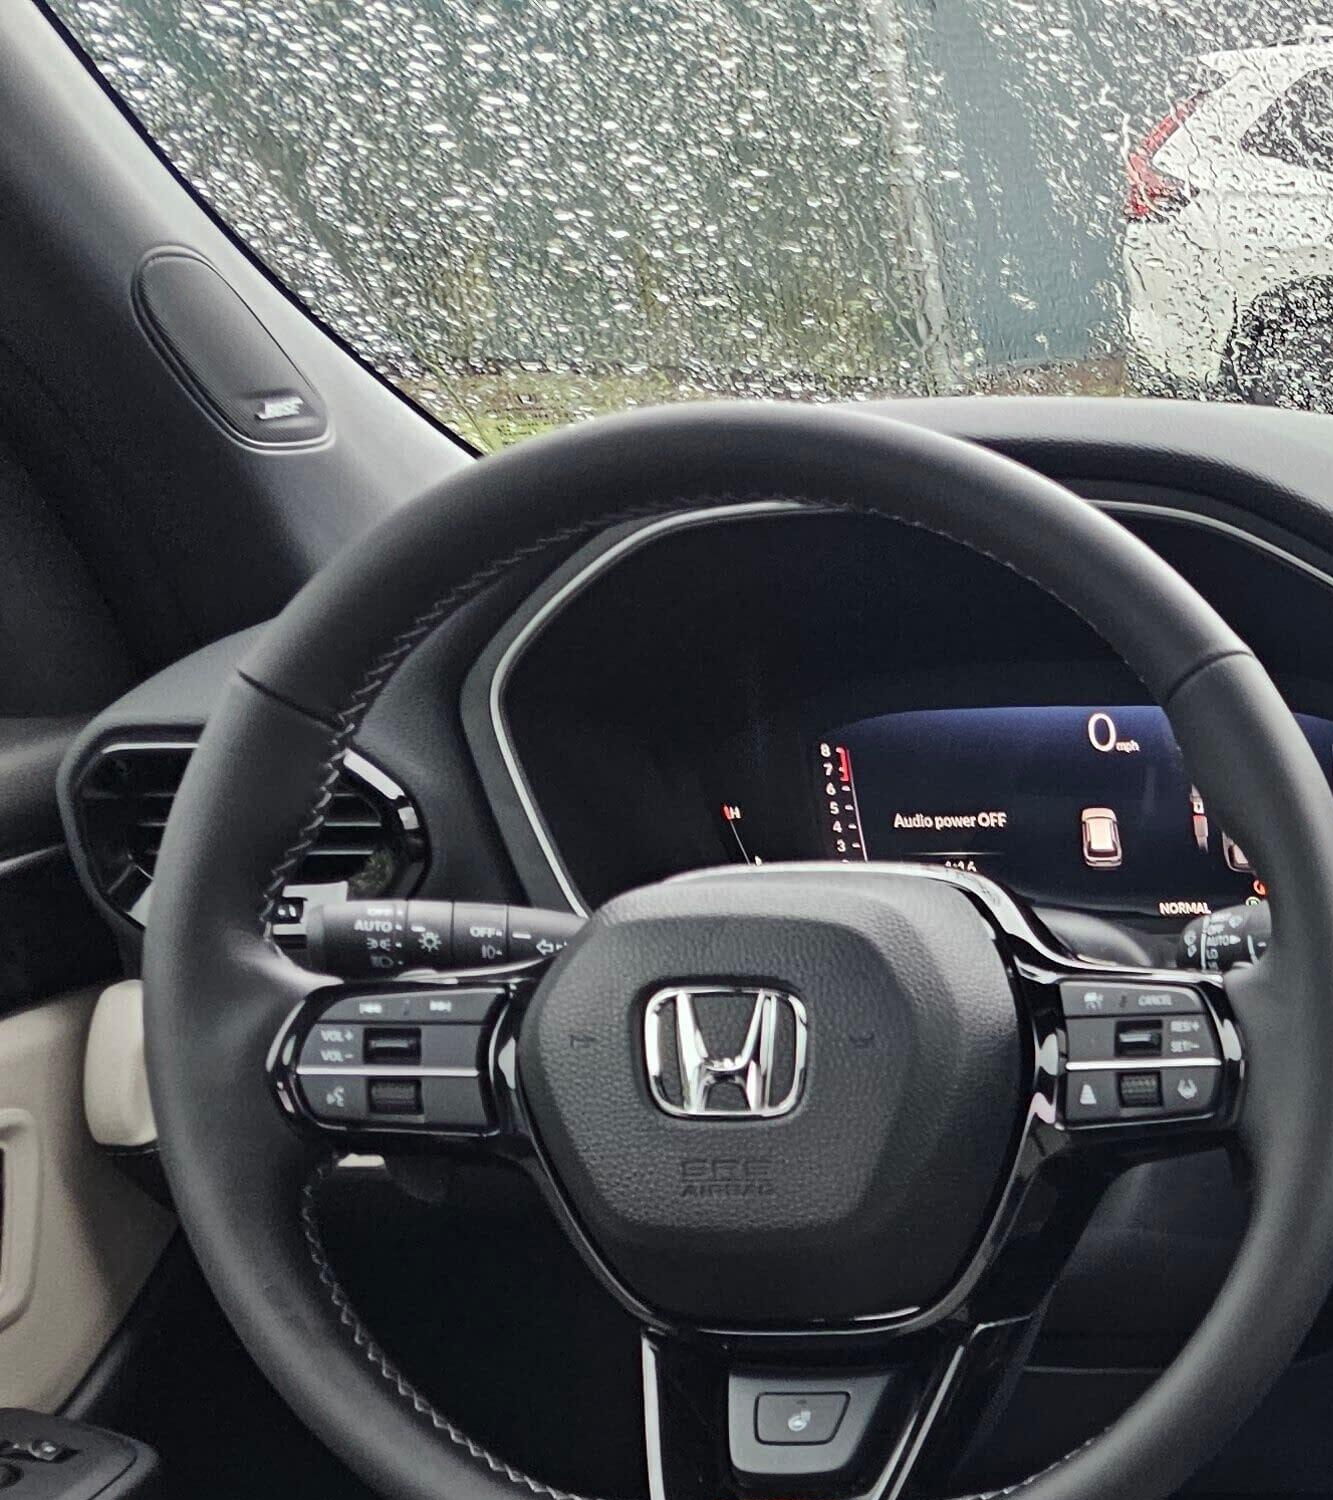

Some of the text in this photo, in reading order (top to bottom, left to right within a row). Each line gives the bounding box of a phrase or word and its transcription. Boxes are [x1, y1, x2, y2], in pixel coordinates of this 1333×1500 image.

[1088, 713, 1140, 754] 0 mph
[820, 744, 830, 758] 8
[824, 762, 833, 776] 7
[826, 782, 836, 796] 6
[830, 802, 840, 814] 5
[832, 820, 842, 834] 4
[894, 812, 1006, 830] Audio power OFF
[836, 839, 846, 852] 3
[1160, 902, 1212, 916] NORMAL
[355, 920, 392, 932] AUTO
